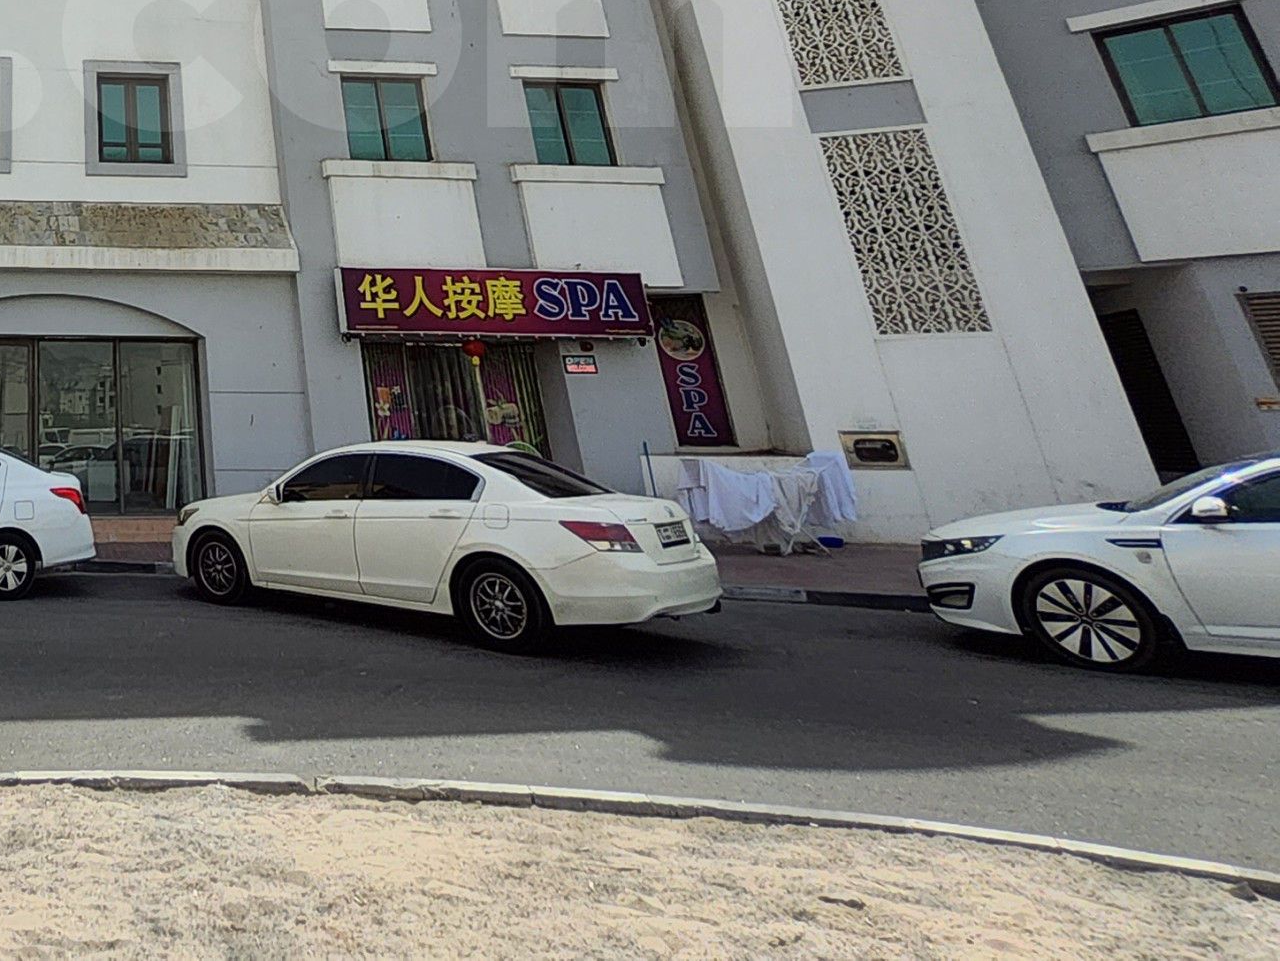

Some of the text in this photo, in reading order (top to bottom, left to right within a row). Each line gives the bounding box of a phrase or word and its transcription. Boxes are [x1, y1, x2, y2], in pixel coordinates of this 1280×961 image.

[357, 273, 527, 321] 华人按摩
[533, 277, 639, 322] SPA
[676, 362, 718, 438] SPA
